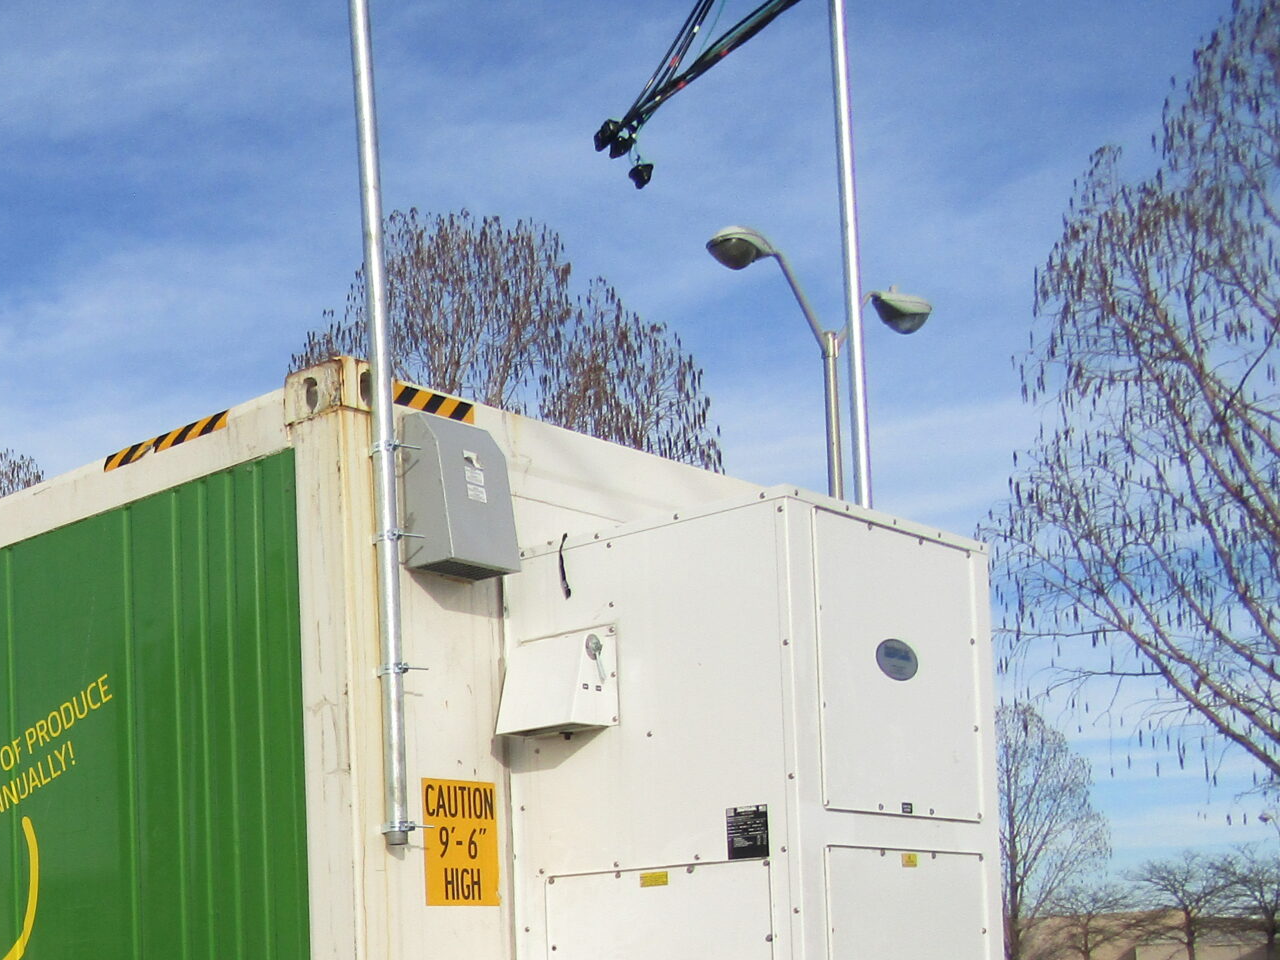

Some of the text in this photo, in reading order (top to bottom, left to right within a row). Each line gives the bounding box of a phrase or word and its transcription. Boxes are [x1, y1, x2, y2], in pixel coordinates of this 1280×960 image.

[0, 736, 22, 771] OF
[24, 673, 113, 755] PRODUCE
[425, 784, 494, 820] CAUTION
[444, 867, 482, 900] HIGH
